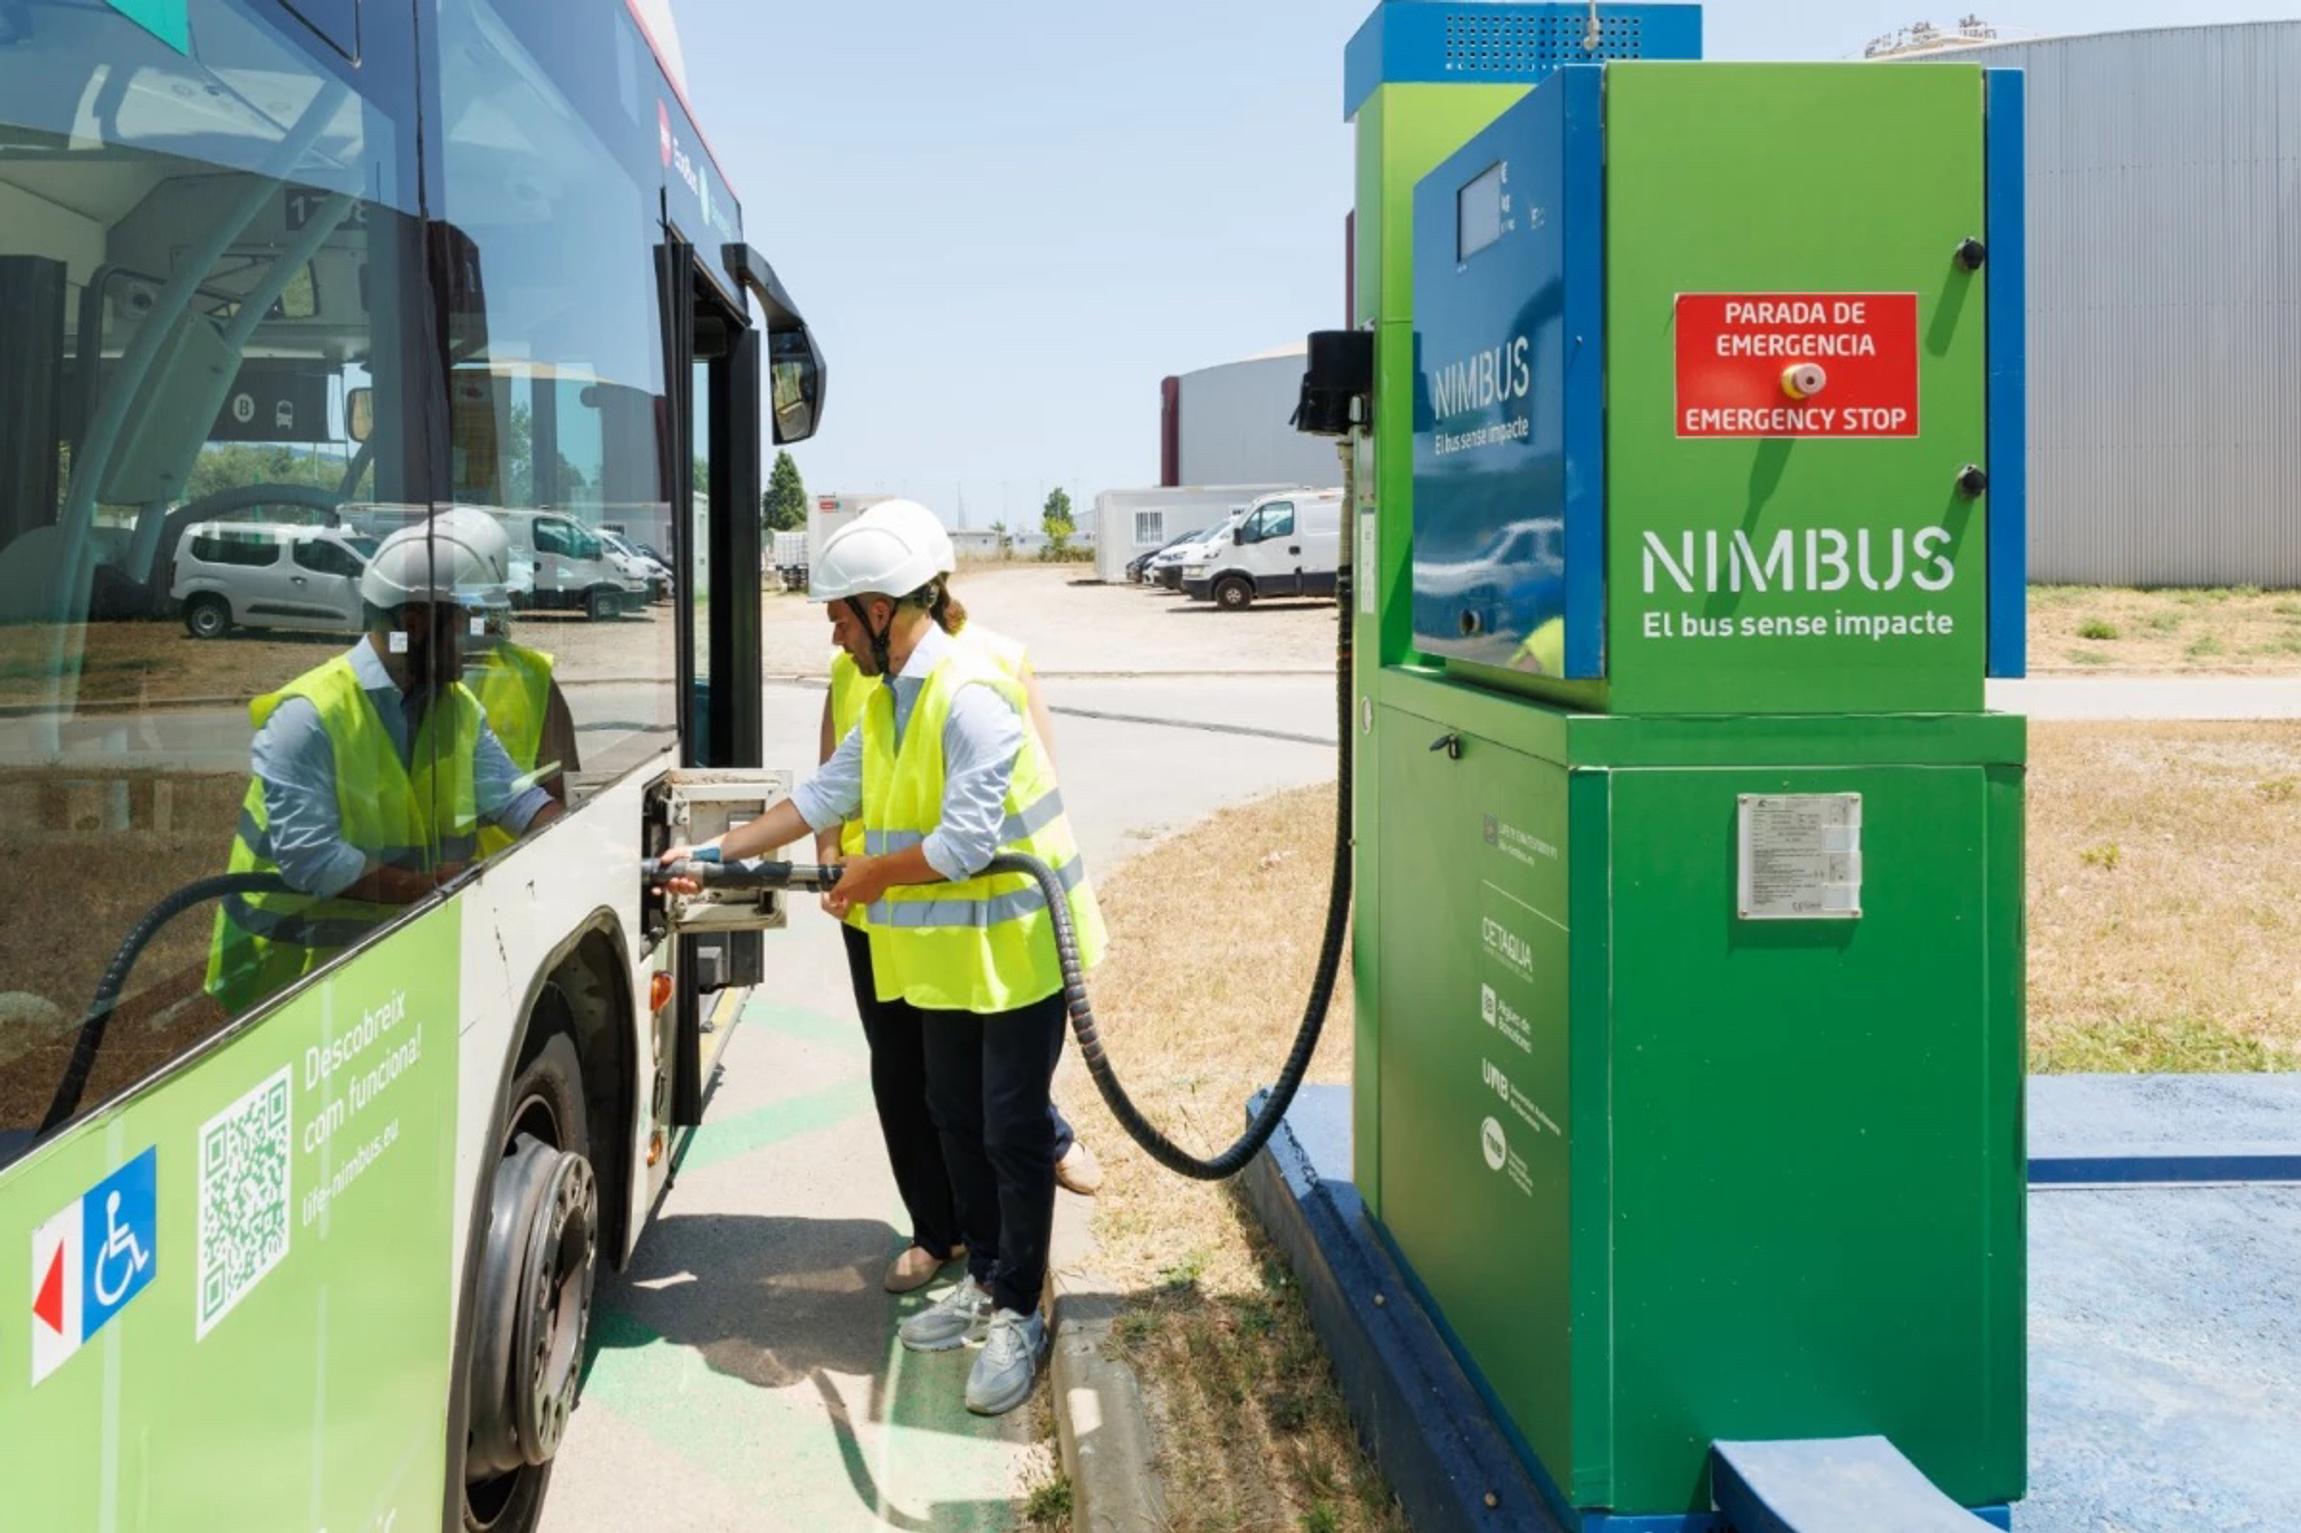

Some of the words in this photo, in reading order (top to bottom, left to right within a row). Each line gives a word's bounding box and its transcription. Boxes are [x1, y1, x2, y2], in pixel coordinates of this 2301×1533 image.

[1725, 302, 1826, 324] PARADA
[1833, 302, 1866, 324] DE
[1716, 334, 1876, 357] EMERGENCIA
[1435, 335, 1530, 421] NIMBUS
[1435, 434, 1445, 455] El
[1445, 432, 1460, 454] bus
[1460, 429, 1487, 451] sense
[1488, 416, 1529, 447] impacte
[1685, 408, 1835, 431] EMERGENCY
[1843, 408, 1907, 430] STOP
[1642, 526, 1955, 593] NIMBUS
[1643, 611, 1673, 638] El
[1681, 611, 1734, 637] bus
[1740, 614, 1828, 636] sense
[1835, 609, 1954, 641] impacte
[305, 987, 405, 1092] Descobreix
[304, 1097, 345, 1154] com
[348, 1021, 422, 1116] funciona!
[302, 1117, 399, 1228] life-nimbus.eu
